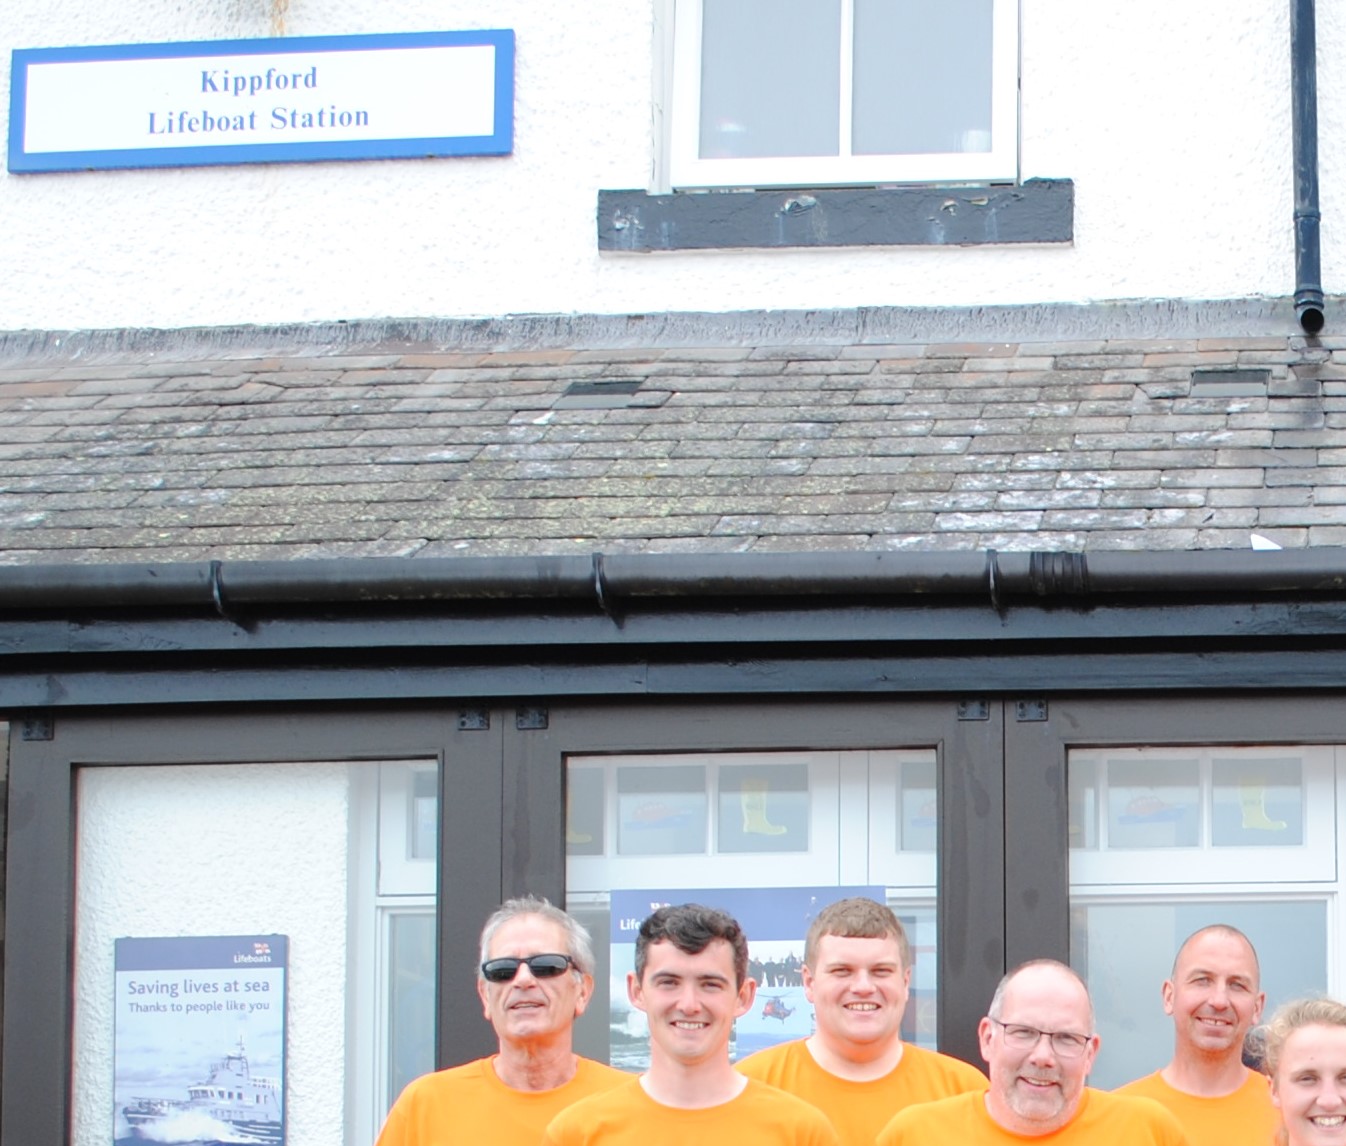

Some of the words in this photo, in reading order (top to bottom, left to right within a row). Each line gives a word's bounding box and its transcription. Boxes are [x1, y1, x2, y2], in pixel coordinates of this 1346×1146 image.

[201, 67, 318, 98] Kippford
[148, 110, 256, 135] Lifeboat
[271, 105, 370, 131] Station
[233, 954, 272, 964] Lifeboats
[128, 980, 179, 998] Saving
[184, 979, 219, 994] lives
[224, 980, 239, 993] at
[244, 981, 270, 992] sea
[128, 1002, 167, 1013] Thanks
[171, 1002, 183, 1013] to
[186, 1002, 222, 1016] people
[226, 1001, 246, 1012] like
[249, 1002, 270, 1014] you
